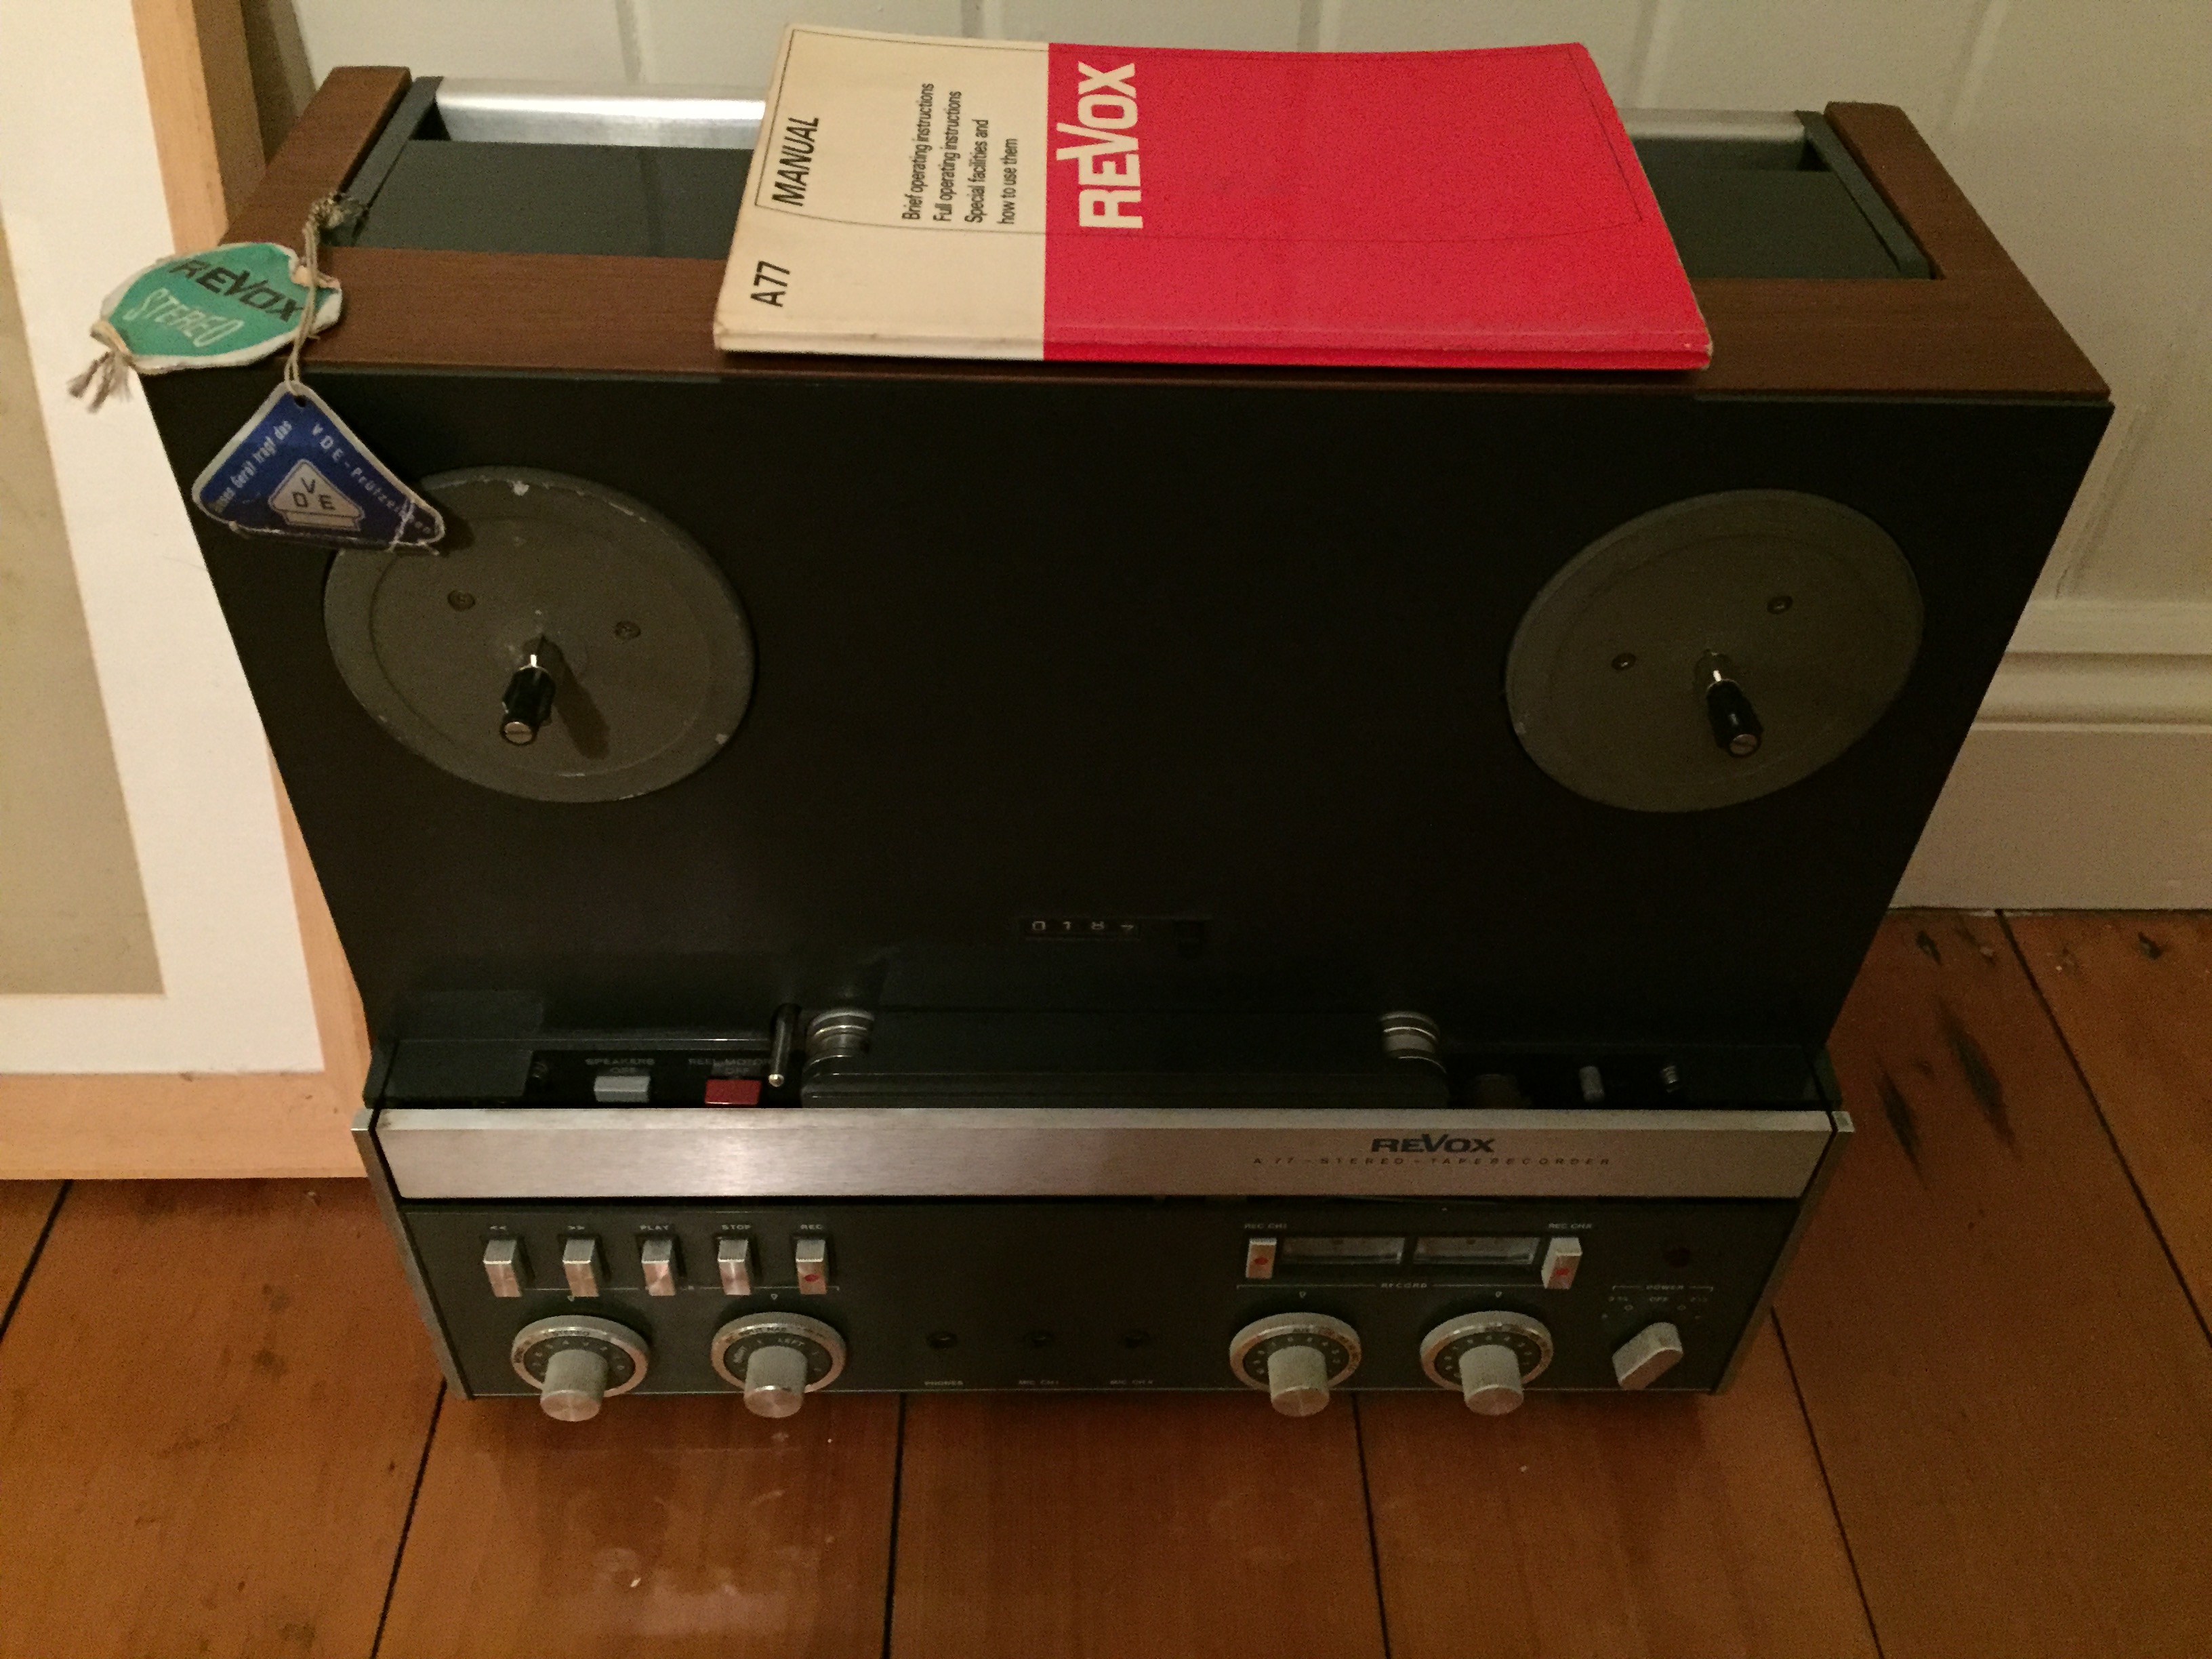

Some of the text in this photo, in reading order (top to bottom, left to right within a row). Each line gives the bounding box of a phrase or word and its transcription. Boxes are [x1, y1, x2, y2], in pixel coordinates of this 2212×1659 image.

[771, 115, 820, 207] MANUAL
[902, 83, 935, 220] Brief operating instructions
[933, 91, 962, 222] Full operating instructions
[964, 119, 989, 223] Special facilities and
[996, 138, 1019, 224] how to use them
[122, 287, 245, 348] STEREO
[750, 260, 791, 308] A77
[585, 1058, 656, 1066] SPEAKERS
[1320, 1157, 1404, 1165] STEREO
[1430, 1157, 1610, 1165] TAPERECORDER
